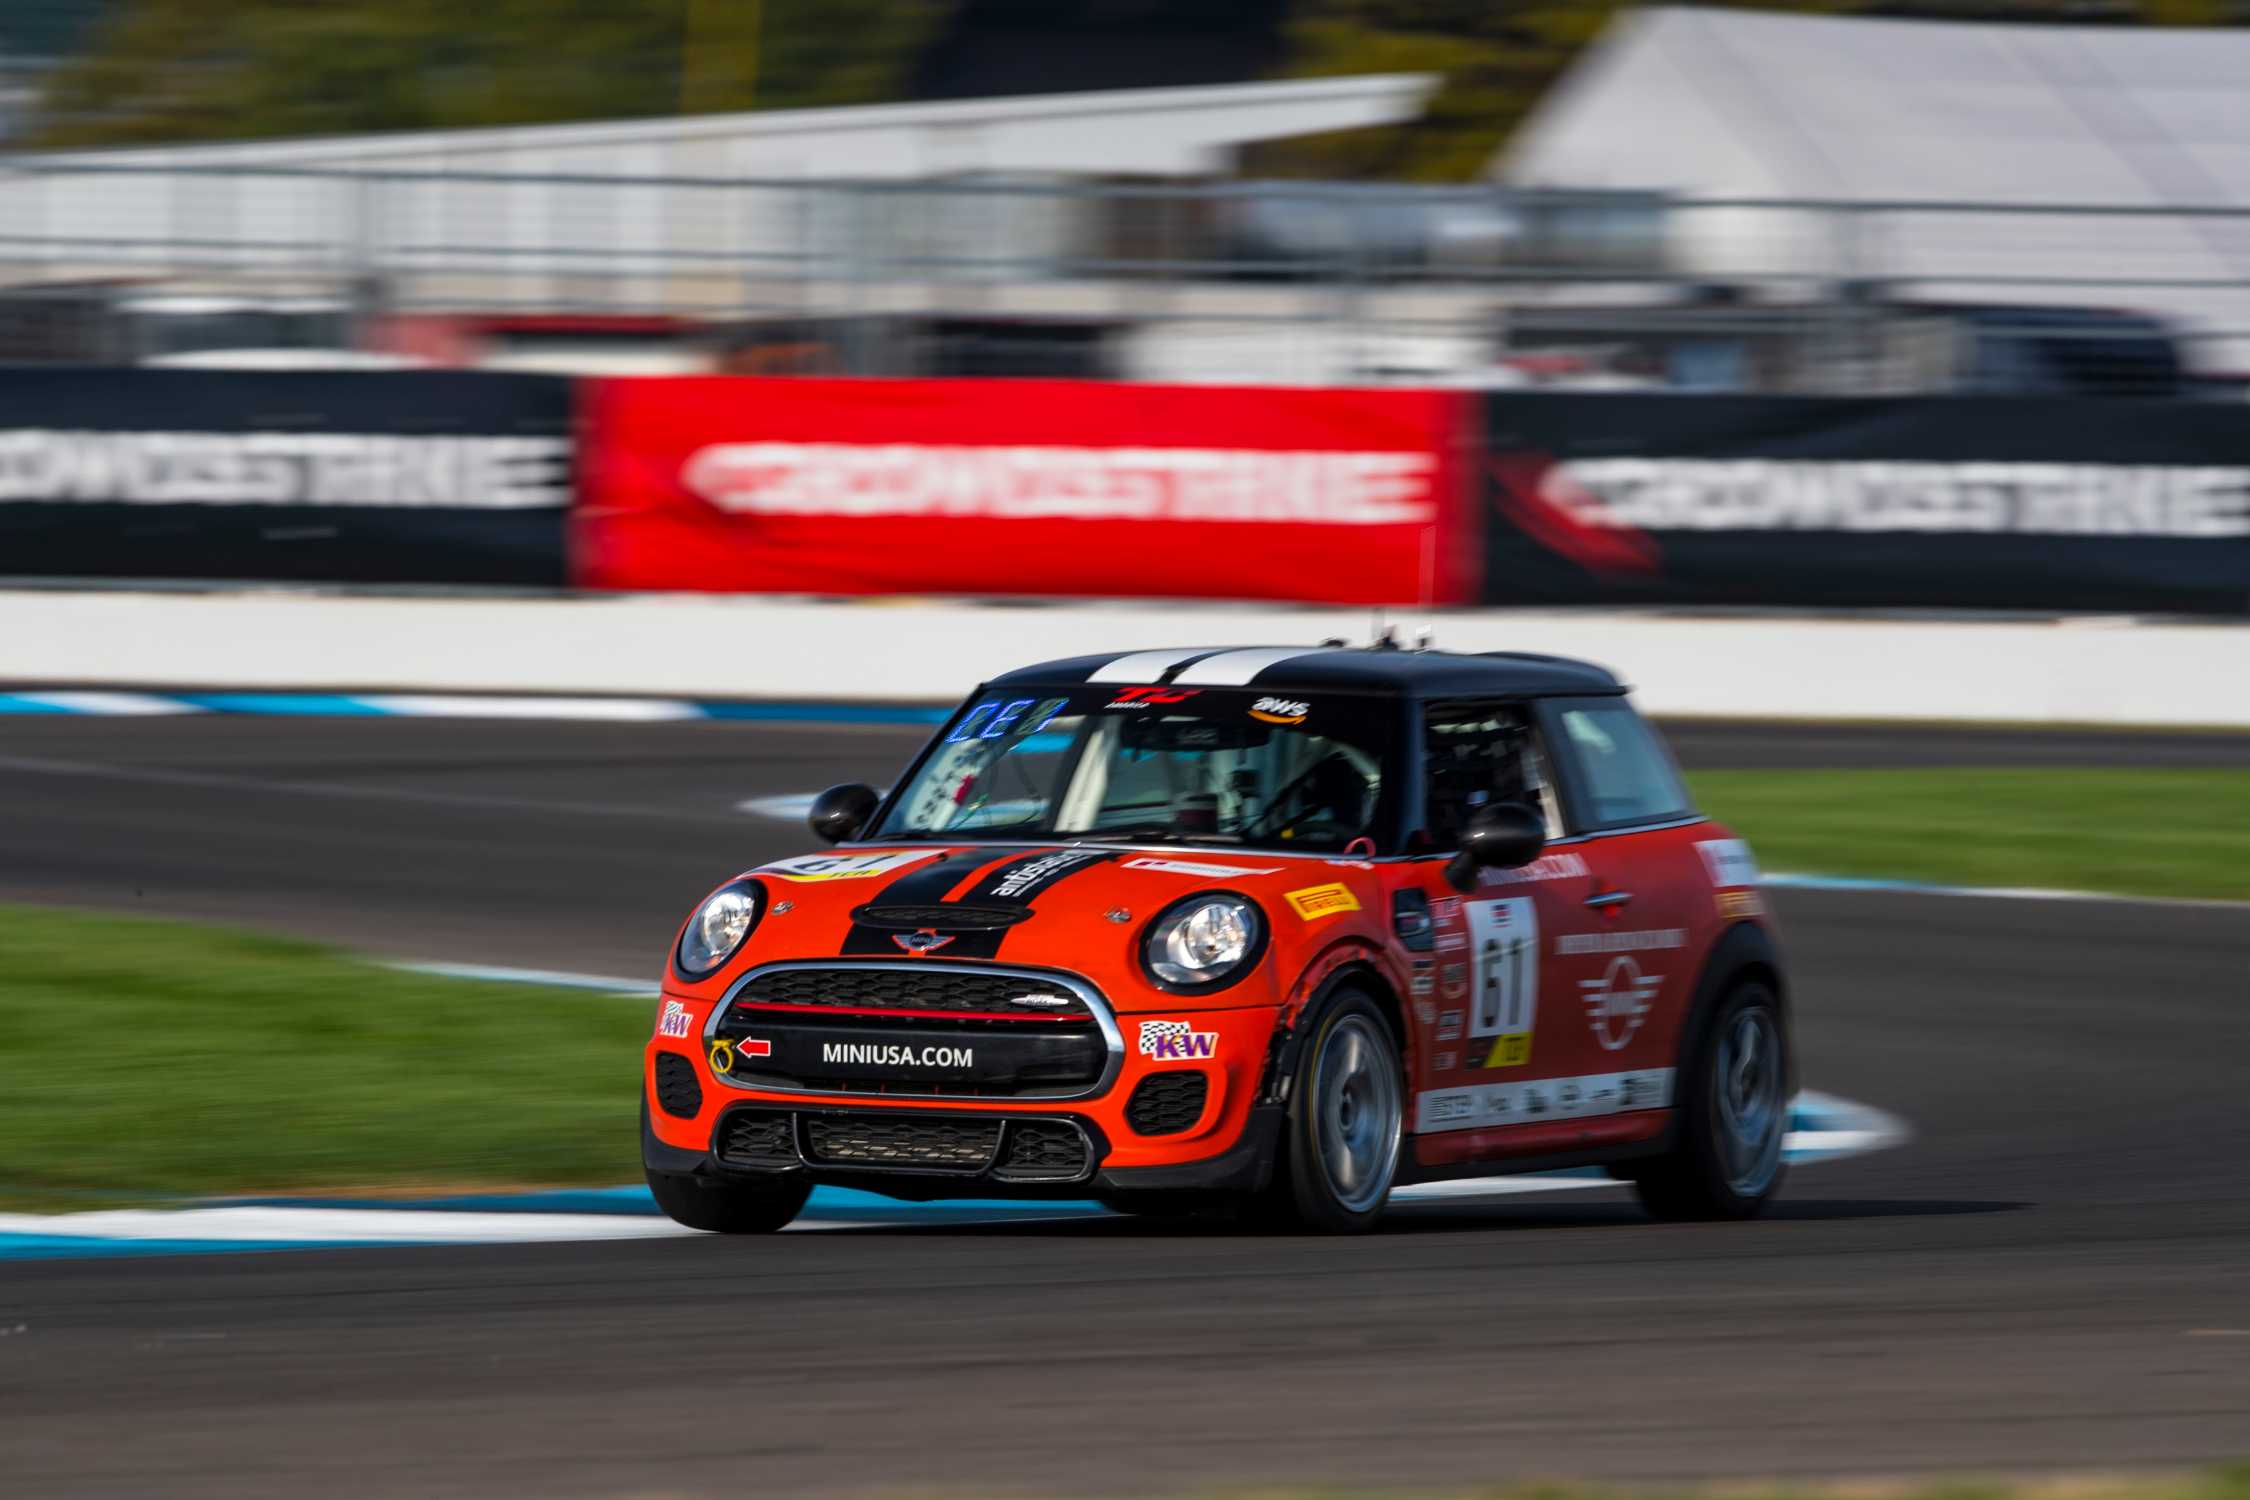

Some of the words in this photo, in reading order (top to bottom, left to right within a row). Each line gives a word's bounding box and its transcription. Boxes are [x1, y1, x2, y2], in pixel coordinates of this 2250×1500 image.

[1252, 697, 1311, 716] aws
[823, 1043, 973, 1068] MINIUSA.COM
[1156, 1034, 1215, 1057] KW
